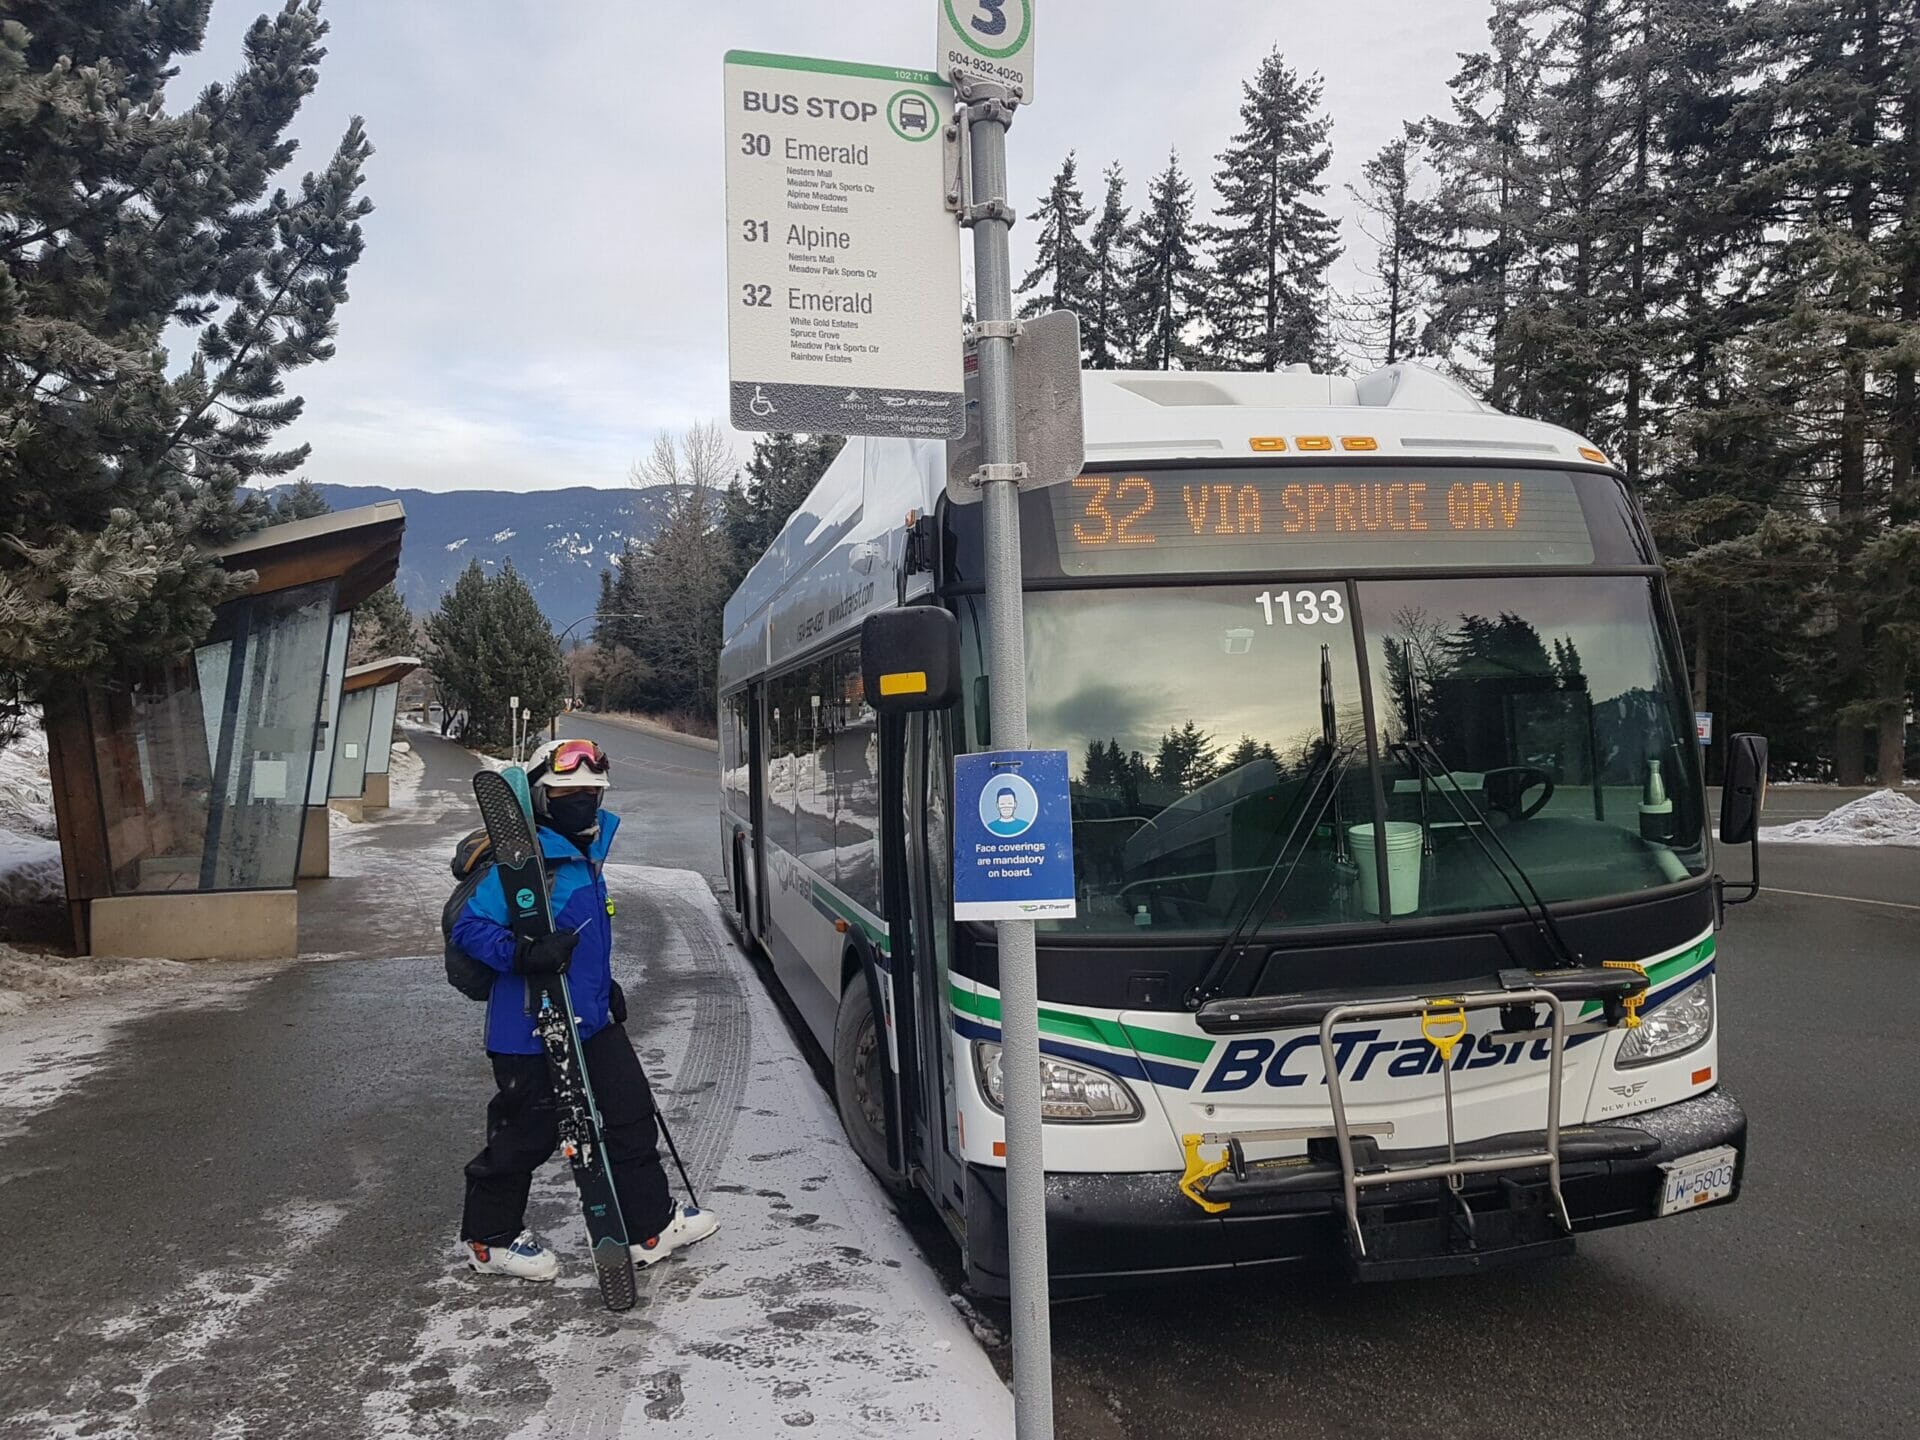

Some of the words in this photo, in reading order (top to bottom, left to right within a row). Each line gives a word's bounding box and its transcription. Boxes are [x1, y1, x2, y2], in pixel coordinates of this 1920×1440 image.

[895, 71, 911, 80] 102
[913, 72, 929, 81] 714
[743, 90, 799, 116] BUS
[806, 97, 878, 122] STOP
[741, 133, 771, 156] 30
[785, 138, 869, 165] Emerald
[787, 166, 815, 176] Nesters
[816, 169, 833, 178] Mall
[787, 178, 818, 188] Meadow
[820, 180, 837, 189] Park
[839, 182, 862, 193] Sports
[864, 184, 875, 193] Ctr
[787, 189, 810, 199] Alpine
[812, 191, 848, 202] Meadows
[787, 201, 819, 211] Rainbow
[821, 203, 849, 213] Estates
[743, 219, 769, 242] 31
[786, 224, 850, 251] Alpine
[788, 252, 817, 262] Nesters
[819, 254, 835, 263] Mall
[789, 264, 820, 274] Meadow
[822, 266, 840, 275] Park
[841, 267, 865, 278] Sports
[866, 269, 877, 278] Ctr
[742, 284, 772, 307] 32
[788, 288, 872, 314] Emerald
[790, 316, 811, 326] White
[813, 318, 830, 327] Gold
[832, 319, 859, 329] Estates
[790, 328, 816, 338] Spruce
[818, 329, 840, 340] Grove
[790, 340, 822, 350] Meadow
[824, 341, 841, 351] Park
[843, 343, 867, 353] Sports
[868, 344, 880, 353] Ctr
[791, 351, 823, 362] Rainbow
[825, 353, 852, 363] Estates
[1072, 477, 1156, 545] 32
[1183, 485, 1261, 535] VIA
[1281, 482, 1428, 533] SPRUCE
[1448, 481, 1521, 529] GRV
[1255, 589, 1345, 625] 1133
[975, 843, 997, 853] Face
[998, 842, 1046, 852] coverings
[977, 858, 991, 866] are
[993, 855, 1045, 865] mandatory
[988, 869, 999, 878] on
[1001, 867, 1033, 877] board.
[1601, 1103, 1624, 1112] NEW
[1693, 1165, 1733, 1194] 5803
